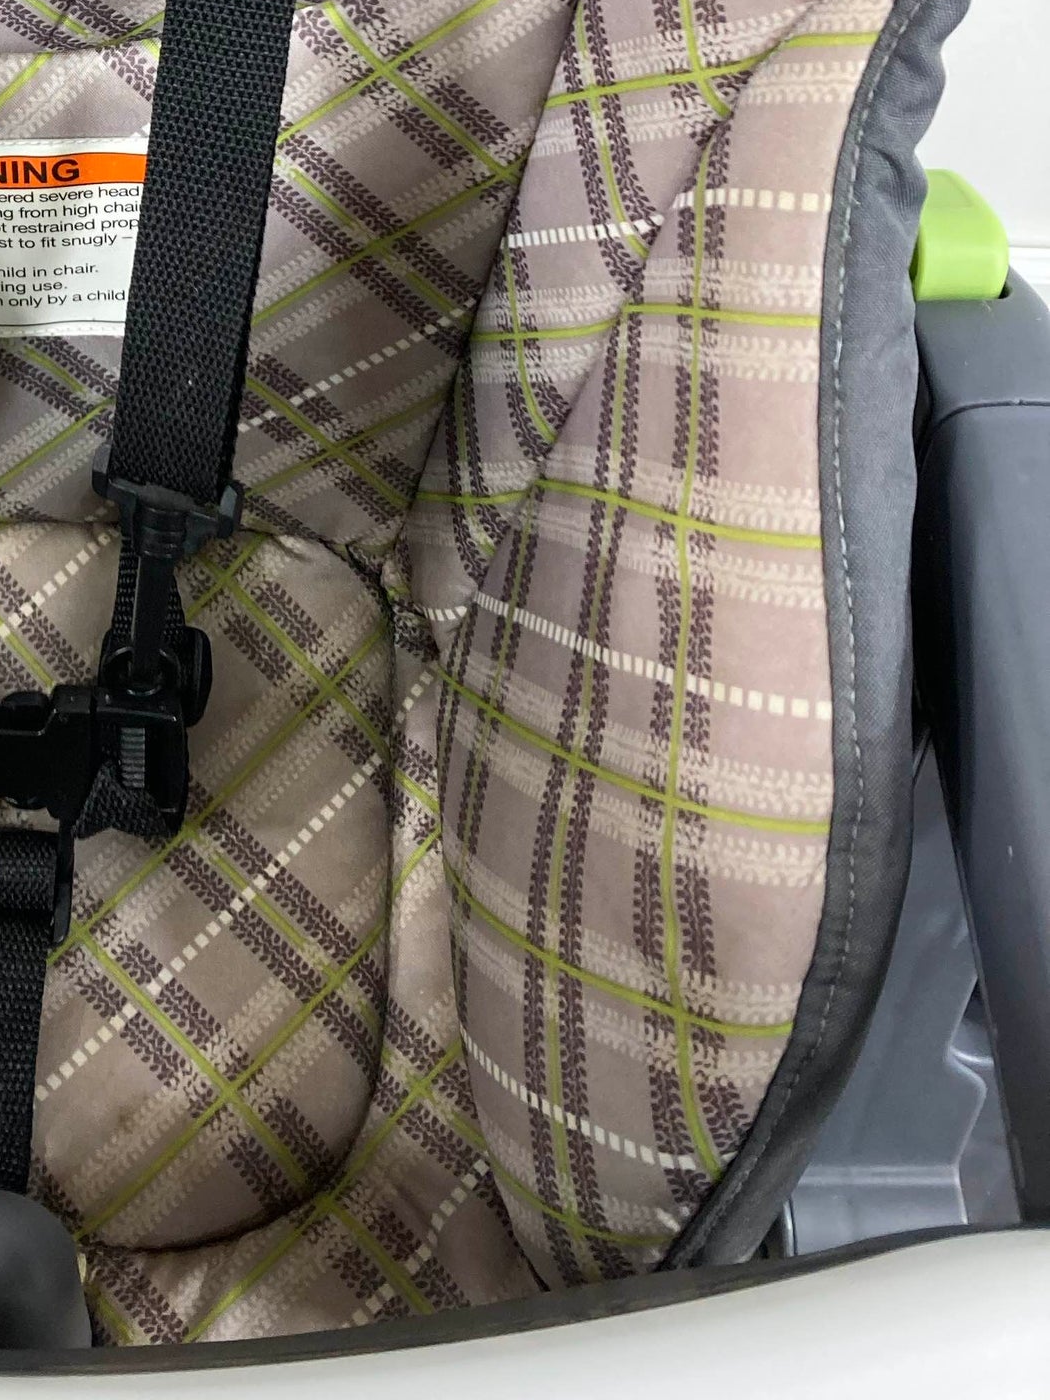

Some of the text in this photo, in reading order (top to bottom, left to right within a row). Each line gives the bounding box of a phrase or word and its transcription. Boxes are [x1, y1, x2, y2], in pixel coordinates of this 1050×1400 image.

[39, 190, 93, 202] severe
[98, 186, 139, 197] head
[19, 207, 57, 218] from
[63, 202, 98, 217] high
[103, 201, 141, 213] chai
[12, 219, 95, 233] restrained
[18, 238, 35, 248] to
[41, 237, 56, 248] fit
[62, 233, 117, 247] snugly
[33, 267, 47, 277] in
[53, 263, 99, 276] chair.
[32, 282, 68, 291] use.
[8, 295, 42, 308] only
[47, 295, 67, 305] by
[72, 293, 82, 301] a
[87, 290, 125, 301] child
